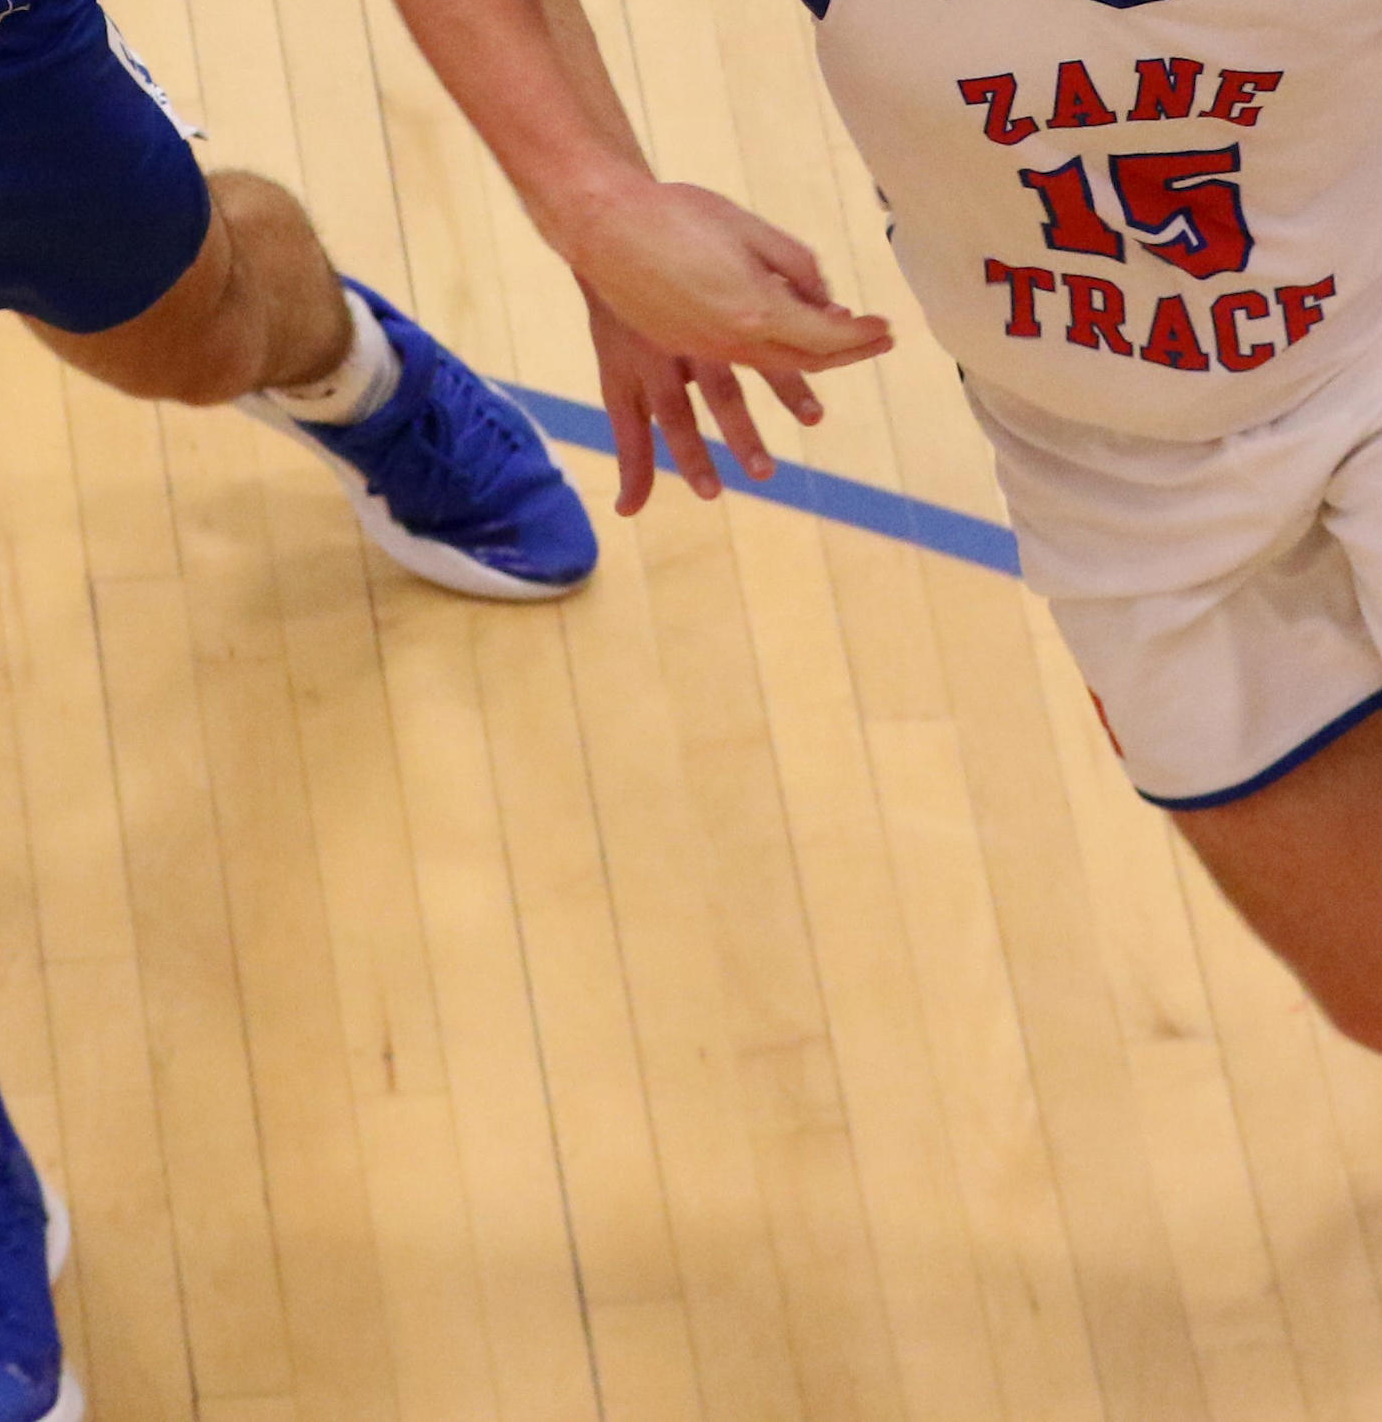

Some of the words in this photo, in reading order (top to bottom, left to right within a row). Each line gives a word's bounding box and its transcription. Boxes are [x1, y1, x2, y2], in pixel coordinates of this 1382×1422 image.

[957, 57, 1284, 146] ZANE
[1017, 142, 1255, 280] 15
[984, 258, 1336, 373] TRACE
